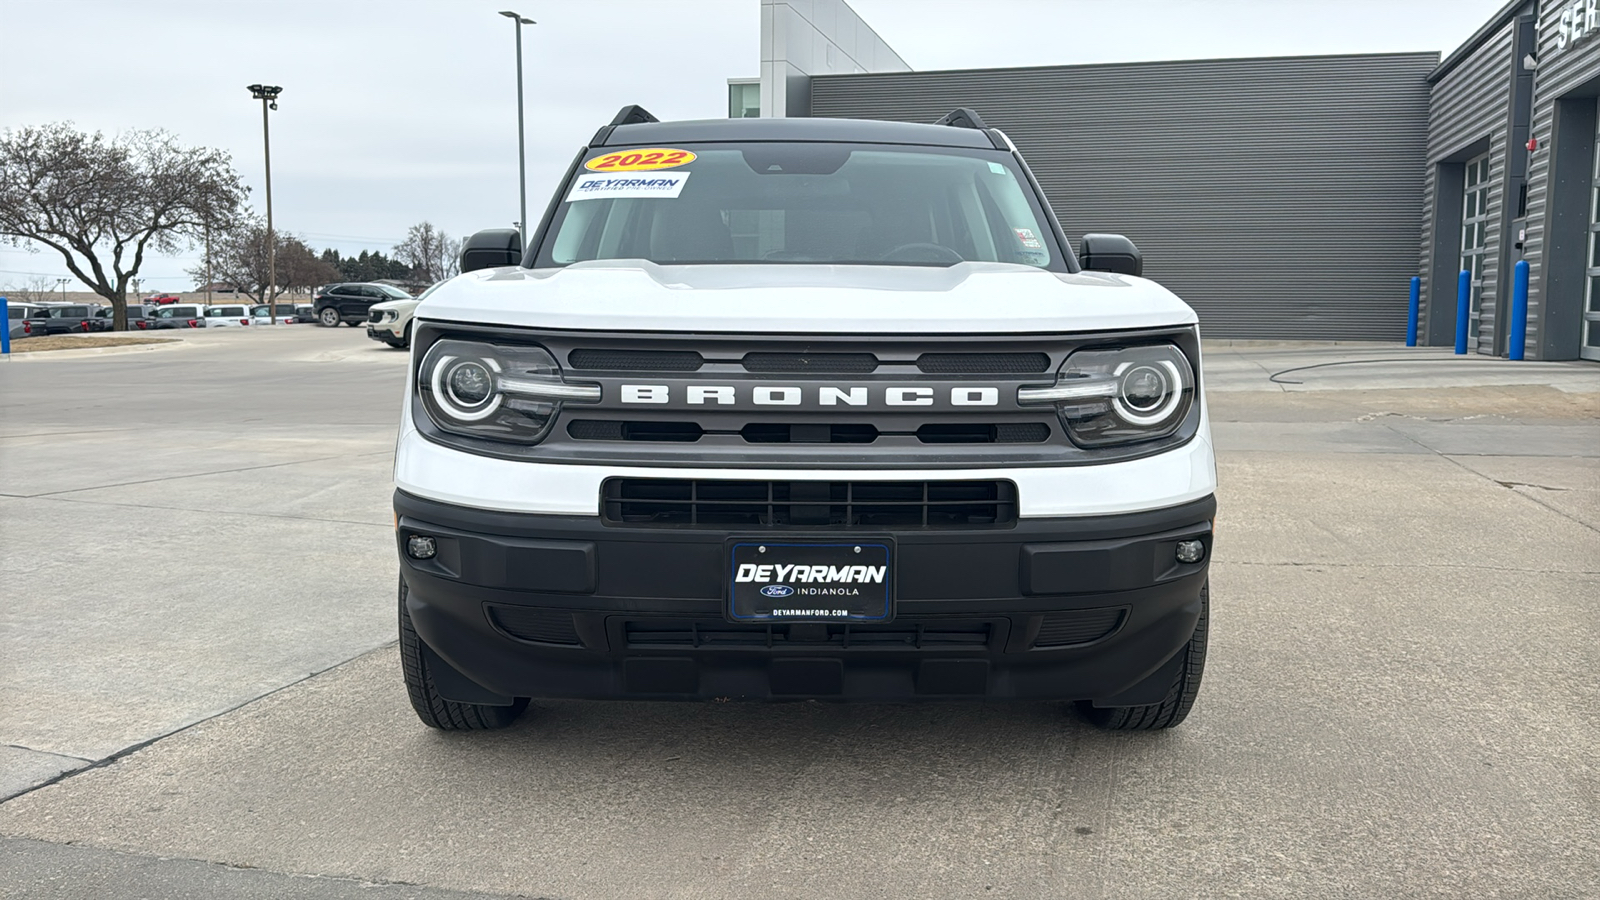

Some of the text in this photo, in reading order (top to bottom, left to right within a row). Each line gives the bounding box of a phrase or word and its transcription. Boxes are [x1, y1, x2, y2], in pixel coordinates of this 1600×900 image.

[595, 152, 688, 168] 2022
[579, 179, 680, 189] DEYARMAN
[621, 385, 999, 406] BRONCO
[735, 564, 887, 583] DEYARMAN
[765, 586, 860, 596] Ford INDIANOLA
